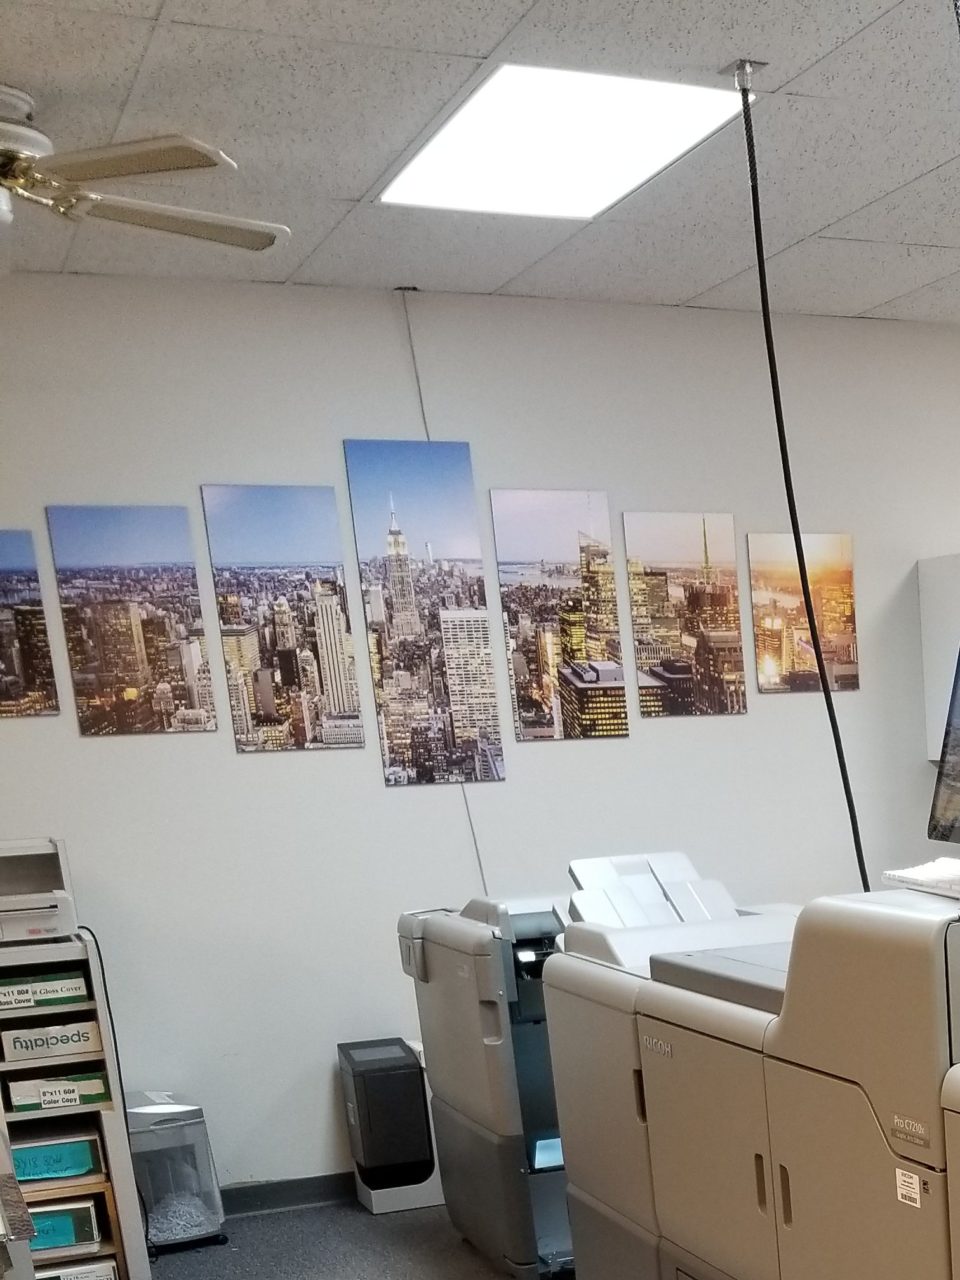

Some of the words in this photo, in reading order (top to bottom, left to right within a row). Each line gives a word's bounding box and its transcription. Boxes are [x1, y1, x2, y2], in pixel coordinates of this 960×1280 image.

[39, 987, 59, 995] Gloss
[60, 985, 82, 993] Cover
[12, 1030, 90, 1051] specialty
[643, 1035, 673, 1058] RICOH
[42, 1098, 60, 1106] Color
[61, 1096, 78, 1104] Copy
[894, 1114, 905, 1128] Pro
